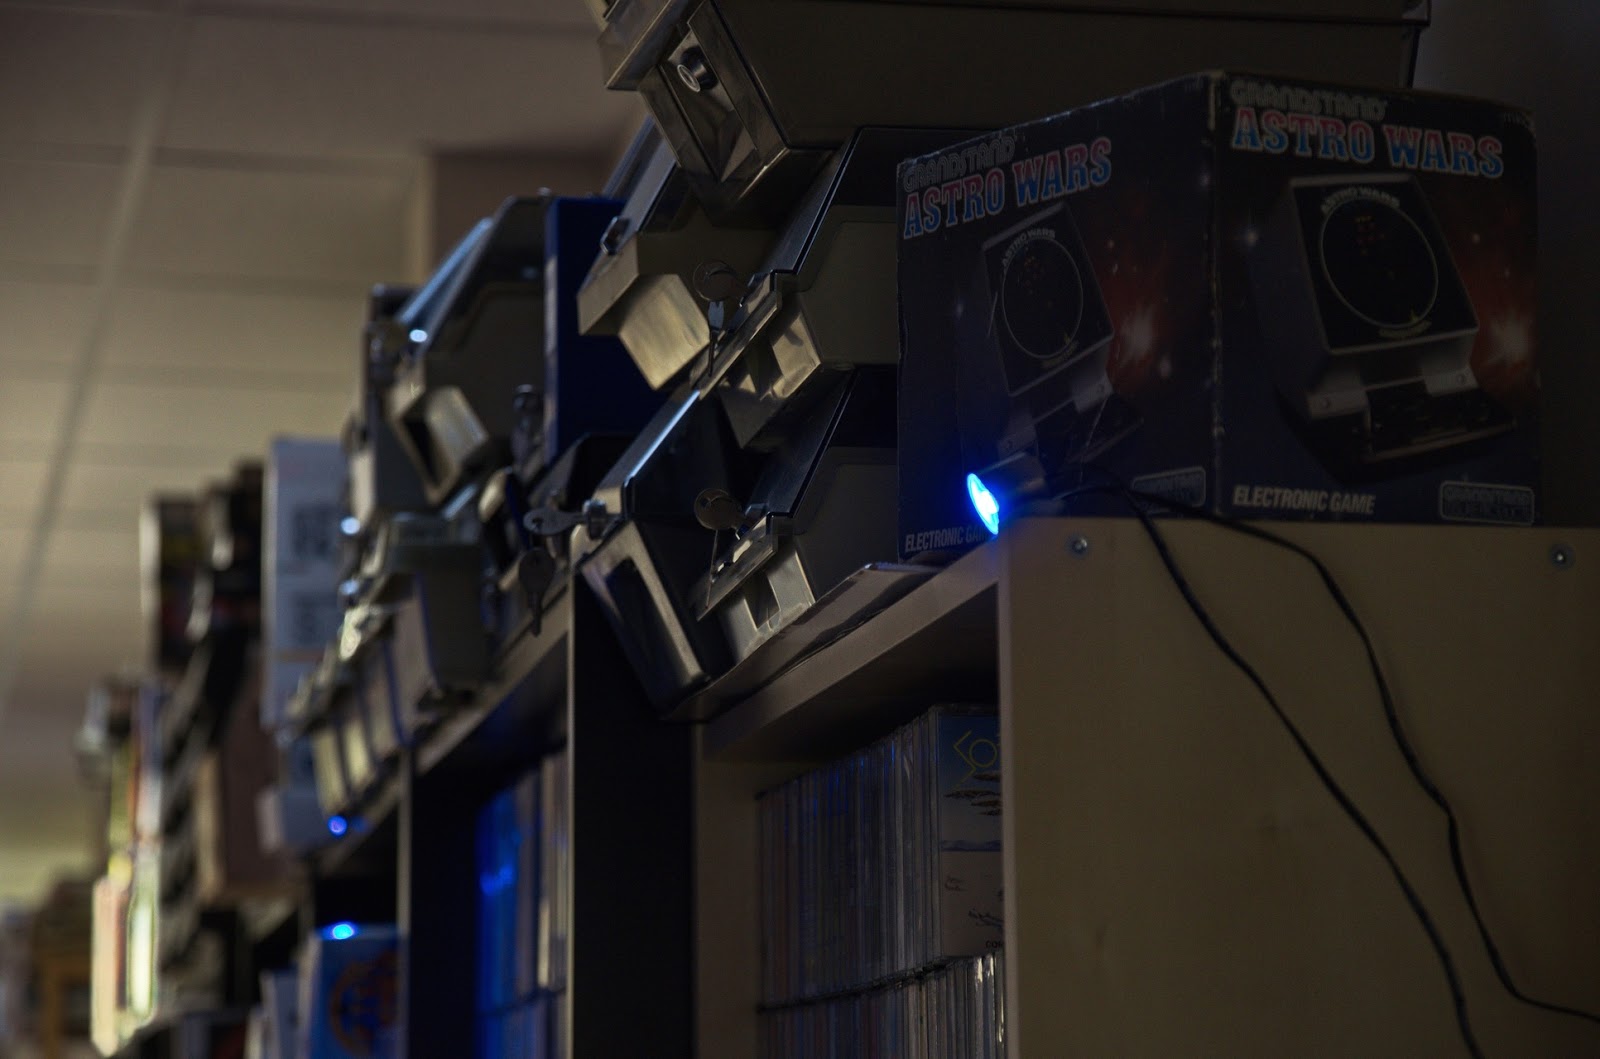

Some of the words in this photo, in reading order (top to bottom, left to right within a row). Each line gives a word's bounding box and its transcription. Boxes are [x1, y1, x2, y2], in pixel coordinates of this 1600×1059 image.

[902, 136, 1016, 192] GRANDSTAND
[1231, 106, 1375, 164] ASTRO
[1382, 123, 1504, 179] WARS
[903, 167, 1005, 239] ASTRO
[1012, 136, 1112, 207] WARS
[1232, 484, 1328, 511] ELECTRONIC
[1329, 491, 1376, 515] GAME
[905, 525, 964, 553] ELECTRONIC
[965, 523, 989, 544] GAM
